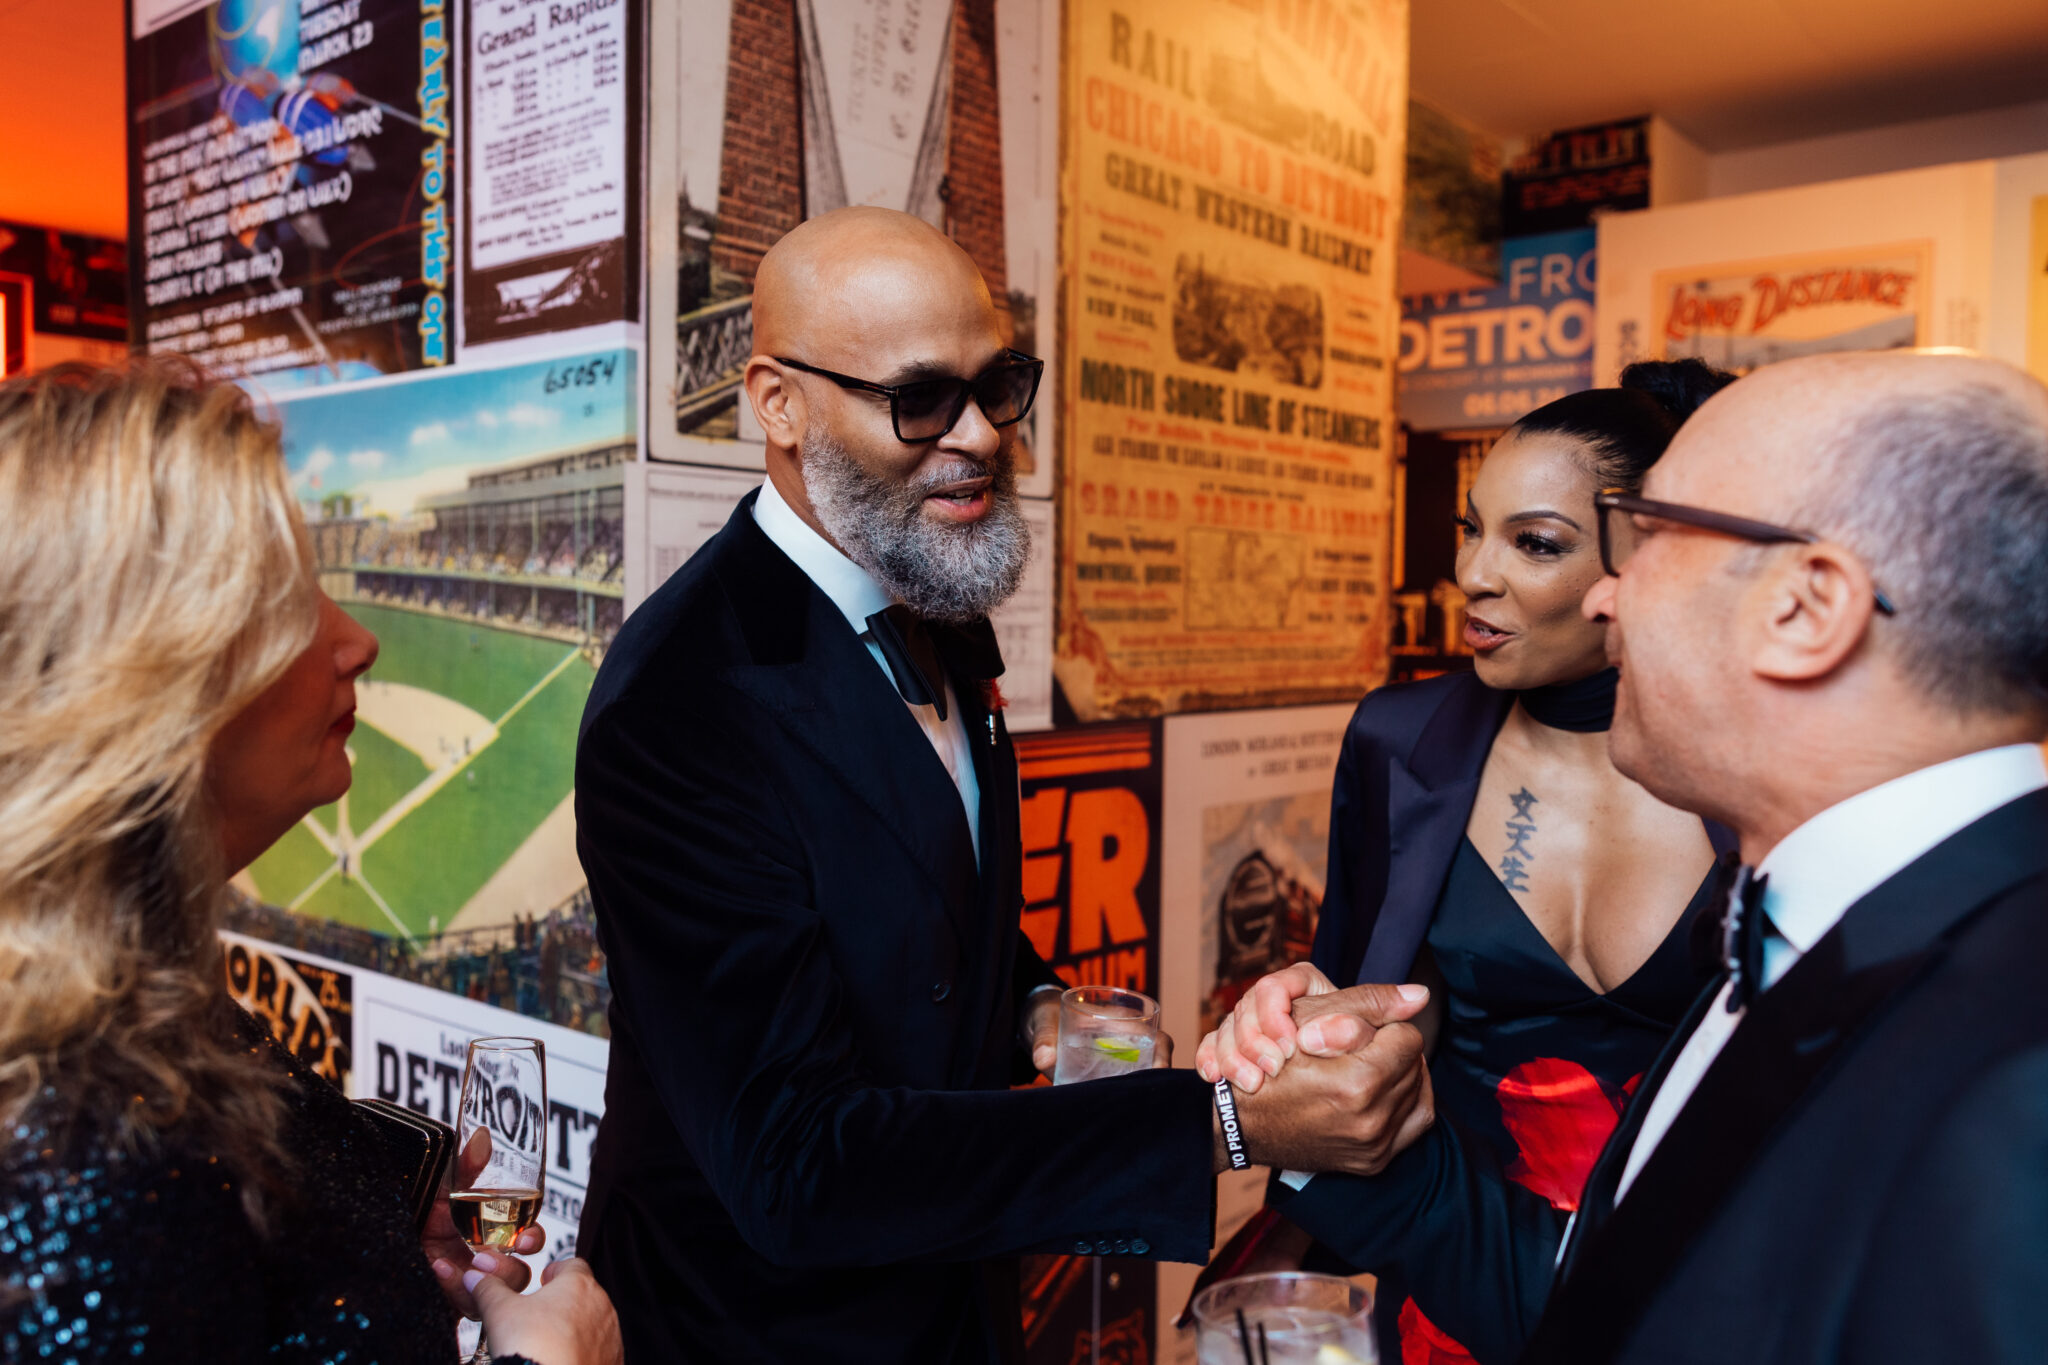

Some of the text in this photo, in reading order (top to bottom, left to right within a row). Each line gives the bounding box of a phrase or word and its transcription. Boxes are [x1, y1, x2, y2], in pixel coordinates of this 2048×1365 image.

[478, 12, 536, 54] Grand
[1110, 10, 1197, 103] RAIL
[1085, 75, 1389, 242] CHICAGO TO DETROIT
[1307, 107, 1377, 178] ROAD
[1105, 150, 1184, 211] GREAT
[1193, 184, 1292, 250] WESTERN
[1299, 222, 1377, 277] RAILWAY
[1400, 298, 1594, 373] DETRO
[1749, 267, 1915, 335] DISTANCE
[544, 352, 618, 394] 65054
[1080, 358, 1381, 450] NORTH SHORE LINE OF STEAMERS
[1080, 481, 1381, 537] GRAND TRUNK RAILWAY
[1231, 1152, 1247, 1169] YO
